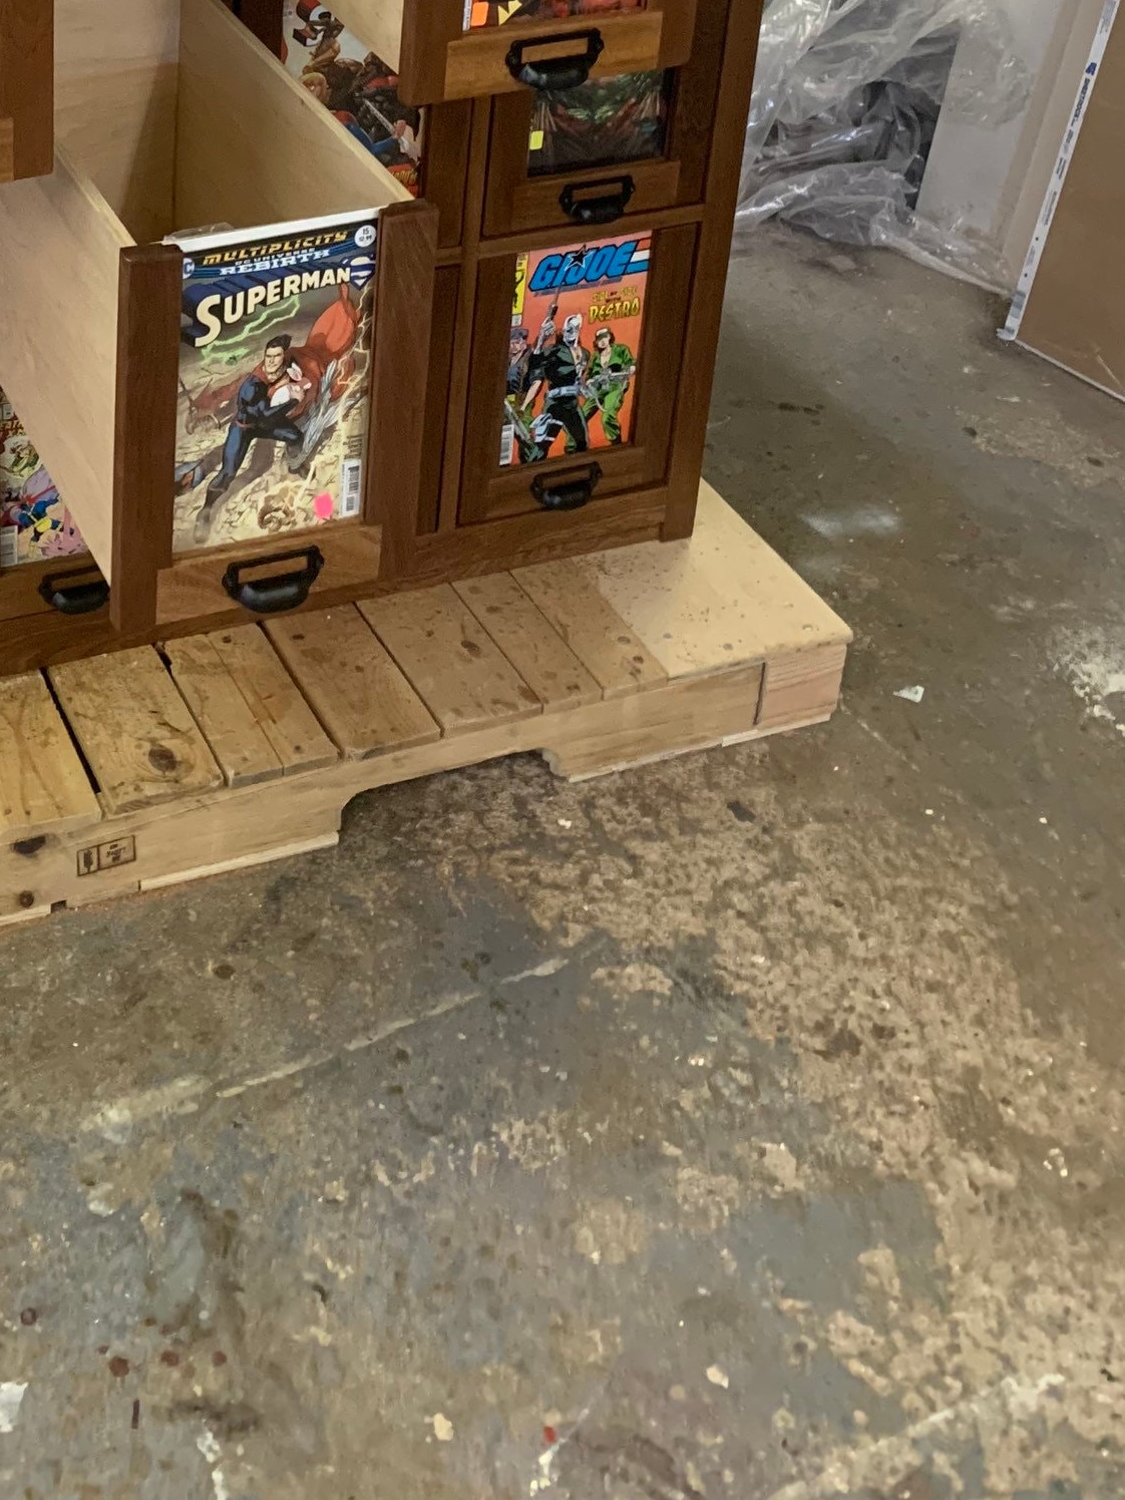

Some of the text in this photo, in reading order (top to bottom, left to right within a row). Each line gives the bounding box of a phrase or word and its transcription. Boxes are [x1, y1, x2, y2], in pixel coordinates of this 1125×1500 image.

[202, 230, 349, 265] MULTIPLICITY
[219, 249, 330, 275] REBIRTH
[194, 267, 351, 347] SUPERMAN
[588, 297, 640, 324] DESTRO
